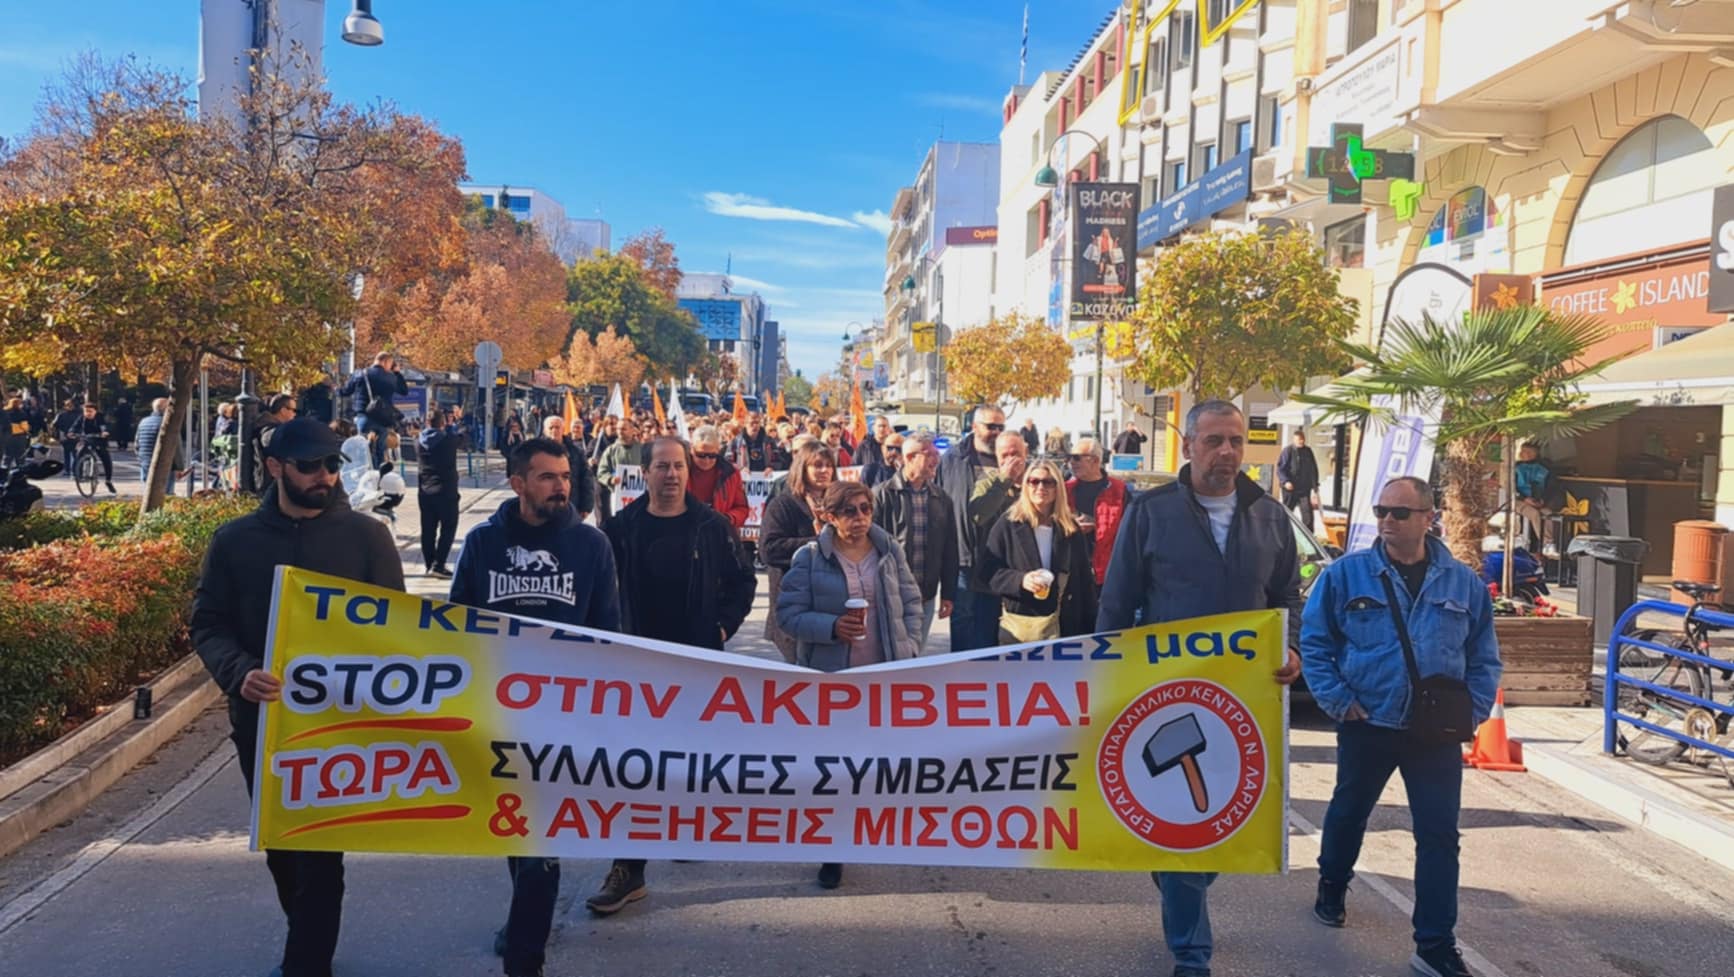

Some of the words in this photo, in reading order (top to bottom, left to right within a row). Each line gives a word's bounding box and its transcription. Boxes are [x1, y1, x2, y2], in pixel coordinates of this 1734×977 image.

[1078, 190, 1133, 209] BLACK
[1086, 217, 1126, 225] MADNESS
[1551, 287, 1609, 316] COFFEE
[1639, 271, 1710, 307] ISLAND
[487, 570, 576, 606] LONSDALE
[304, 585, 390, 626] Τα
[1146, 630, 1257, 664] μας
[290, 663, 463, 706] STOP
[495, 673, 683, 719] στην
[699, 676, 1091, 727] ΑΚΡΙΒΕΙΑ!
[1190, 685, 1251, 737] ΚΕΝΤΡΟ
[279, 747, 452, 802] ΤΩΡΑ
[489, 741, 797, 796] ΣΥΛΛΟΓΙΚΕΣ
[812, 752, 1079, 796] ΣΥΜΒΑΣΕΙΣ
[488, 792, 530, 838] &
[545, 797, 834, 845] ΑΥΞΗΣΕΙΣ
[853, 805, 1079, 851] ΜΙΣΘΩΝ
[1211, 765, 1260, 836] ΛΑΡΙΣΑΣ
